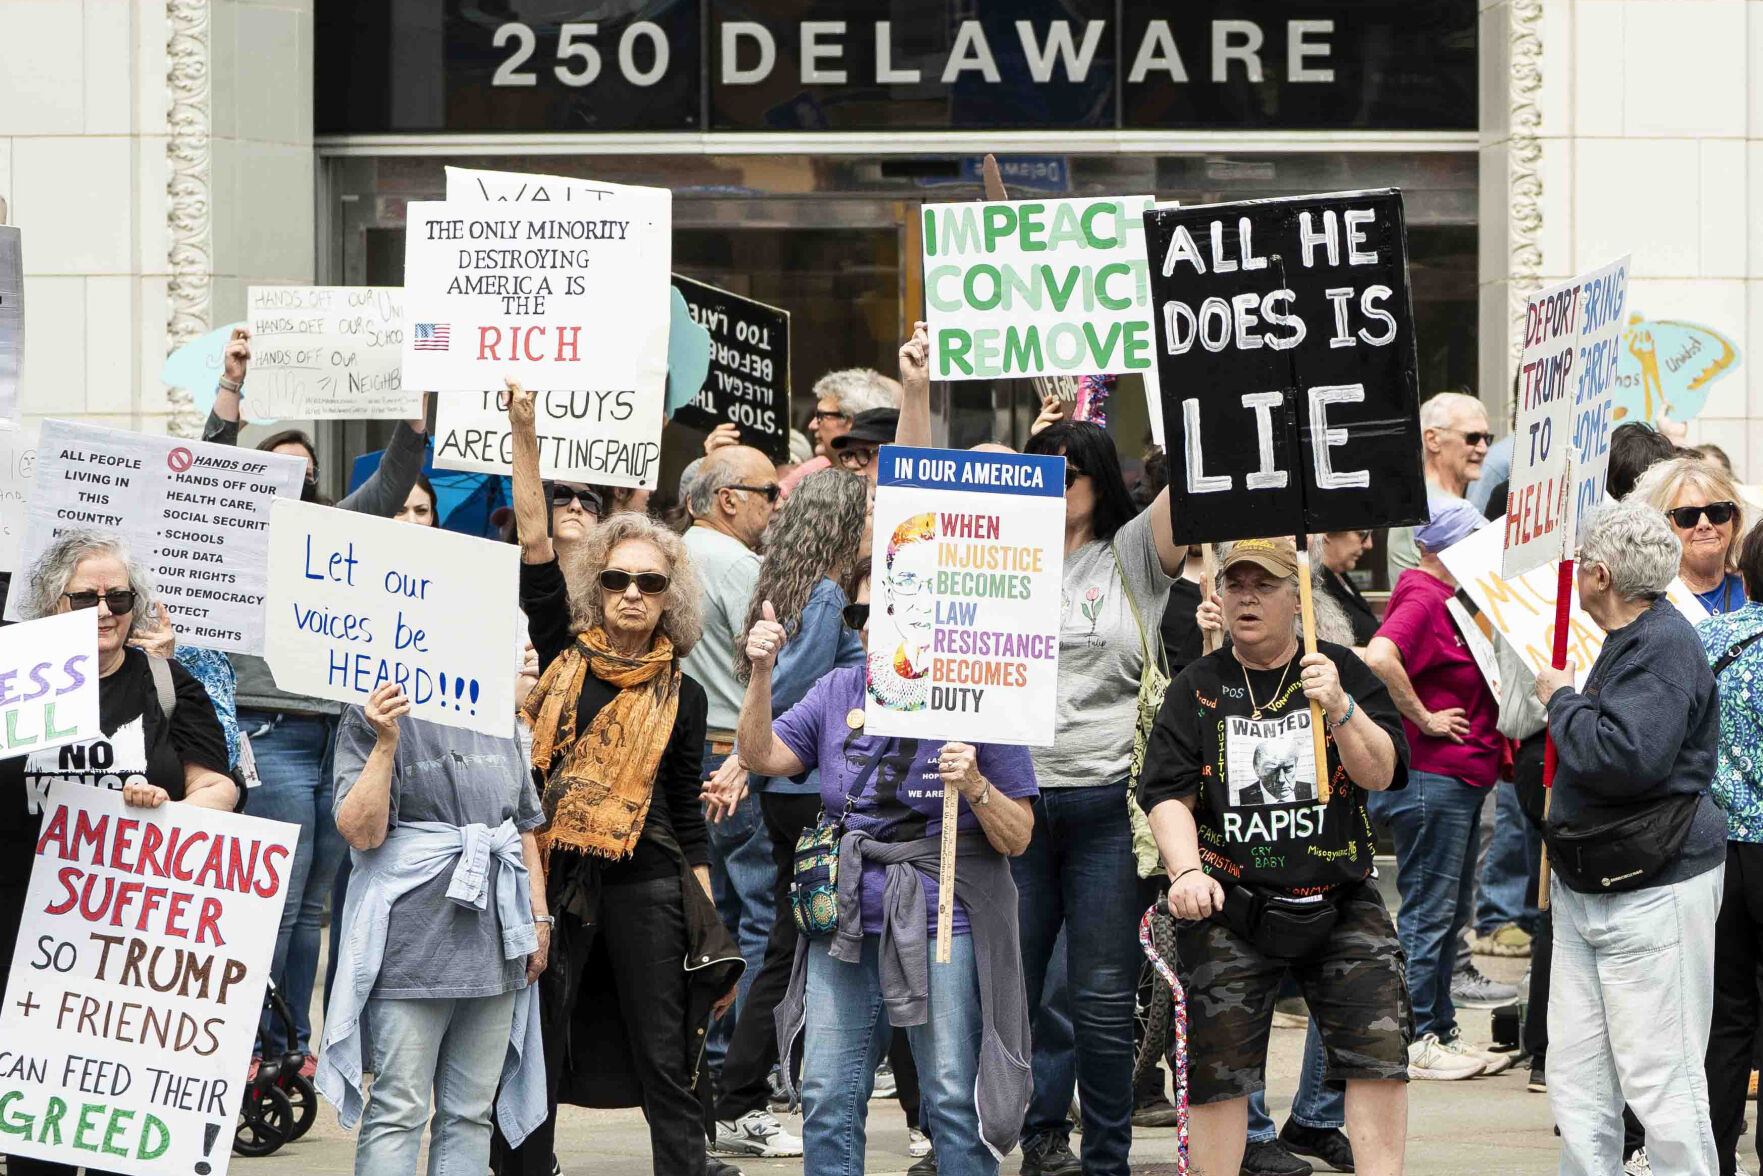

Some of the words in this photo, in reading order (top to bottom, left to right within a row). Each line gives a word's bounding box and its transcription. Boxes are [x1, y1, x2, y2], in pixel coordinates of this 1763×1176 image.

[492, 21, 670, 87] 250
[721, 20, 1335, 84] DELAWARE
[425, 220, 464, 240] THE
[469, 220, 521, 240] ONLY
[526, 220, 630, 240] MINORITY
[924, 200, 1155, 256] IMPEACH
[1162, 217, 1268, 277] ALL
[1299, 208, 1379, 268] HE
[458, 249, 590, 269] DESTROYING
[255, 291, 302, 308] HANDS
[309, 290, 334, 308] OFF
[348, 289, 375, 308] OUR
[447, 275, 553, 295] AMERICA
[565, 275, 586, 295] IS
[927, 259, 1151, 313] CONVICT
[501, 296, 546, 315] THE
[1163, 289, 1307, 355] DOES
[1325, 285, 1397, 348] IS
[1524, 284, 1582, 350] DEPORT
[256, 318, 294, 334] HANDS
[300, 318, 325, 334] OFF
[338, 316, 365, 335] OUR
[736, 320, 772, 350] TOO
[255, 350, 292, 366] HANDS
[296, 347, 324, 364] OFF
[331, 351, 358, 367] OUR
[476, 325, 582, 361] RICH
[938, 321, 1152, 376] REMOVE
[714, 370, 773, 406] ILLEGAL
[1523, 347, 1574, 411] TRUMP
[545, 391, 636, 422] GUYS
[727, 402, 777, 434] STOP
[1182, 383, 1371, 494] LIE
[1529, 416, 1552, 467] TO
[60, 449, 85, 462] ALL
[89, 453, 142, 470] PEOPLE
[193, 455, 239, 470] HANDS
[241, 462, 268, 474] OFF
[894, 457, 914, 480] IN
[918, 458, 956, 483] OUR
[961, 462, 1044, 488] AMERICA
[64, 470, 111, 485] LIVING
[115, 476, 130, 488] IN
[175, 473, 219, 487] HANDS
[222, 480, 247, 491] OFF
[250, 483, 277, 495] OUR
[78, 491, 110, 505] THIS
[166, 490, 216, 506] HEALTH
[219, 498, 257, 513] CARE,
[57, 509, 124, 526] COUNTRY
[163, 509, 209, 523] SOCIAL
[212, 515, 270, 531] SECURIT
[940, 512, 1000, 540] WHEN
[165, 529, 225, 545] SCHOOLS
[161, 547, 189, 560] OUR
[192, 551, 224, 564] DATA
[304, 534, 359, 587] Let
[384, 570, 433, 600] our
[937, 543, 1044, 573] INJUSTICE
[158, 566, 185, 578] OUR
[189, 569, 236, 584] RIGHTS
[936, 571, 1032, 600] BECOMES
[186, 587, 264, 606] DEMOCRACY
[294, 602, 373, 643] voices
[395, 611, 430, 653] be
[934, 600, 978, 628] LAW
[195, 626, 242, 641] RIGHTS
[933, 628, 1056, 660] RESISTANCE
[932, 658, 1028, 688] BECOMES
[931, 686, 985, 713] DUTY
[1222, 685, 1245, 699] POS
[1232, 712, 1311, 739] WANTED
[59, 741, 114, 770] NO
[908, 789, 922, 798] WE
[925, 789, 945, 798] ARE
[1223, 804, 1328, 843] RAPIST
[36, 804, 290, 899] AMERICANS
[1251, 846, 1273, 856] CRY
[1255, 855, 1285, 868] BABY
[44, 866, 227, 947] SUFFER
[30, 935, 78, 973] SO
[90, 931, 248, 1005] TRUMP
[56, 991, 226, 1057] FRIENDS
[62, 1054, 132, 1097] FEED
[146, 1066, 229, 1117] THEIR
[0, 1090, 171, 1161] GREED
